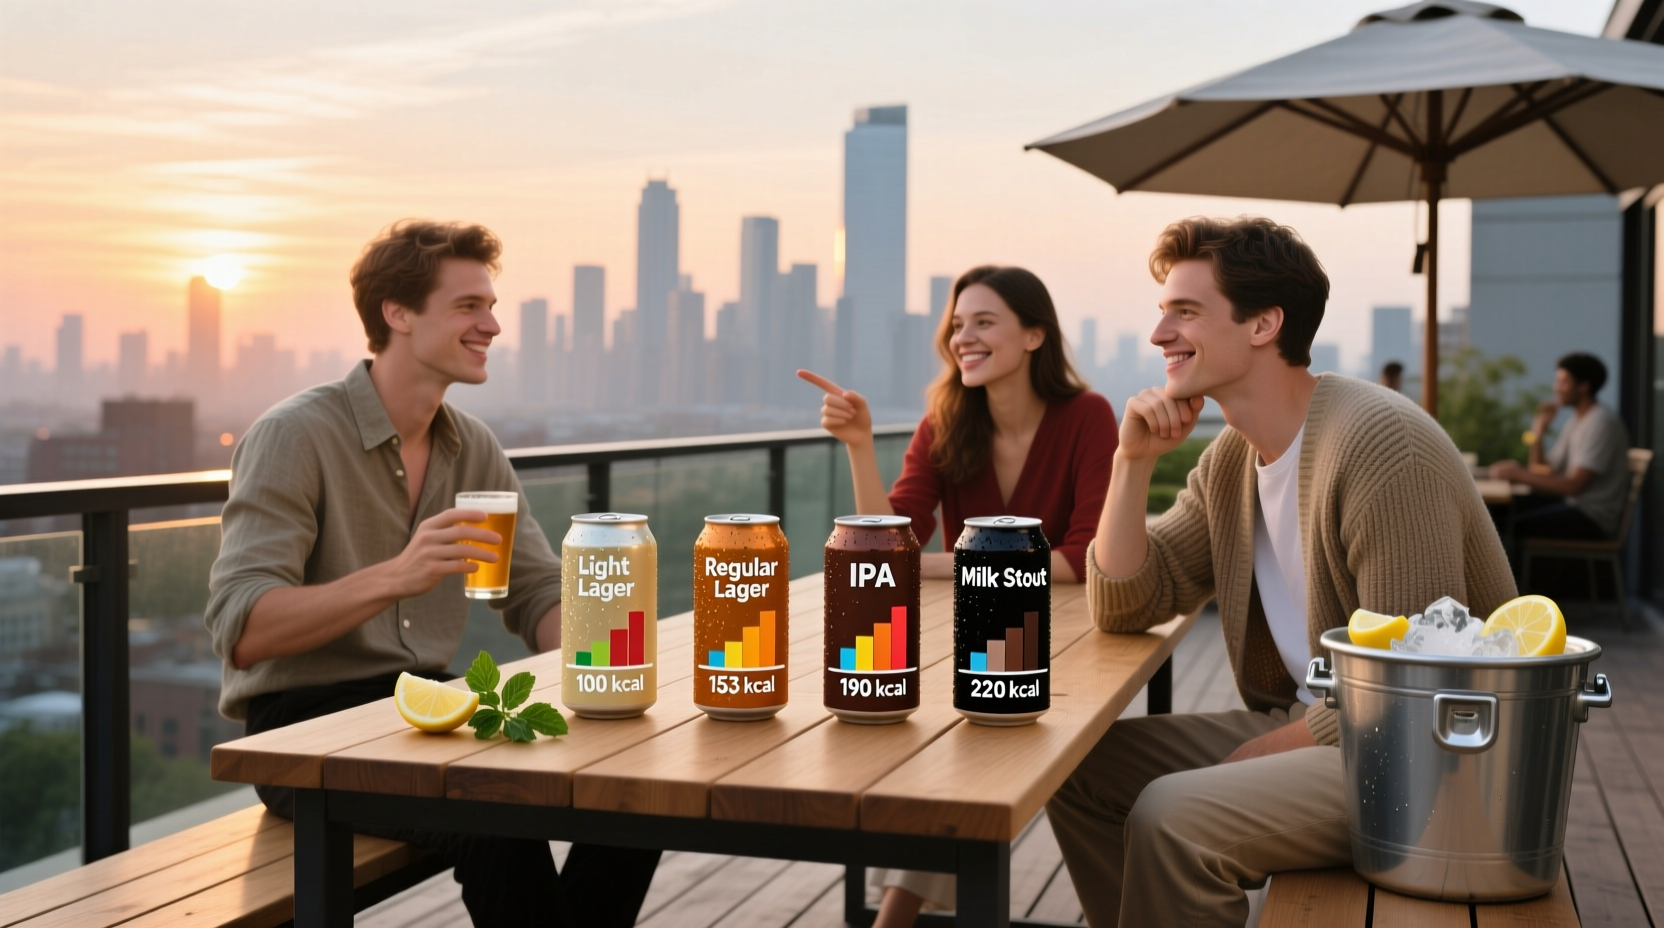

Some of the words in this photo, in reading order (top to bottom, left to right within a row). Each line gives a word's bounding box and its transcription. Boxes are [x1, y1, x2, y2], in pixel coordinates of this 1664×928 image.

[578, 556, 630, 580] Light
[705, 558, 778, 582] Regular
[850, 563, 896, 588] IPA
[961, 567, 999, 588] Milk
[1003, 568, 1047, 588] Stout
[578, 579, 635, 602] Lager
[715, 580, 769, 603] Lager
[576, 675, 607, 693] 100
[612, 675, 644, 692] kcal
[709, 676, 740, 694] 153
[744, 676, 775, 693] kcal
[840, 678, 872, 697] 190
[875, 679, 906, 697] kcal
[971, 680, 1006, 698] 220
[1009, 681, 1039, 698] kcal
